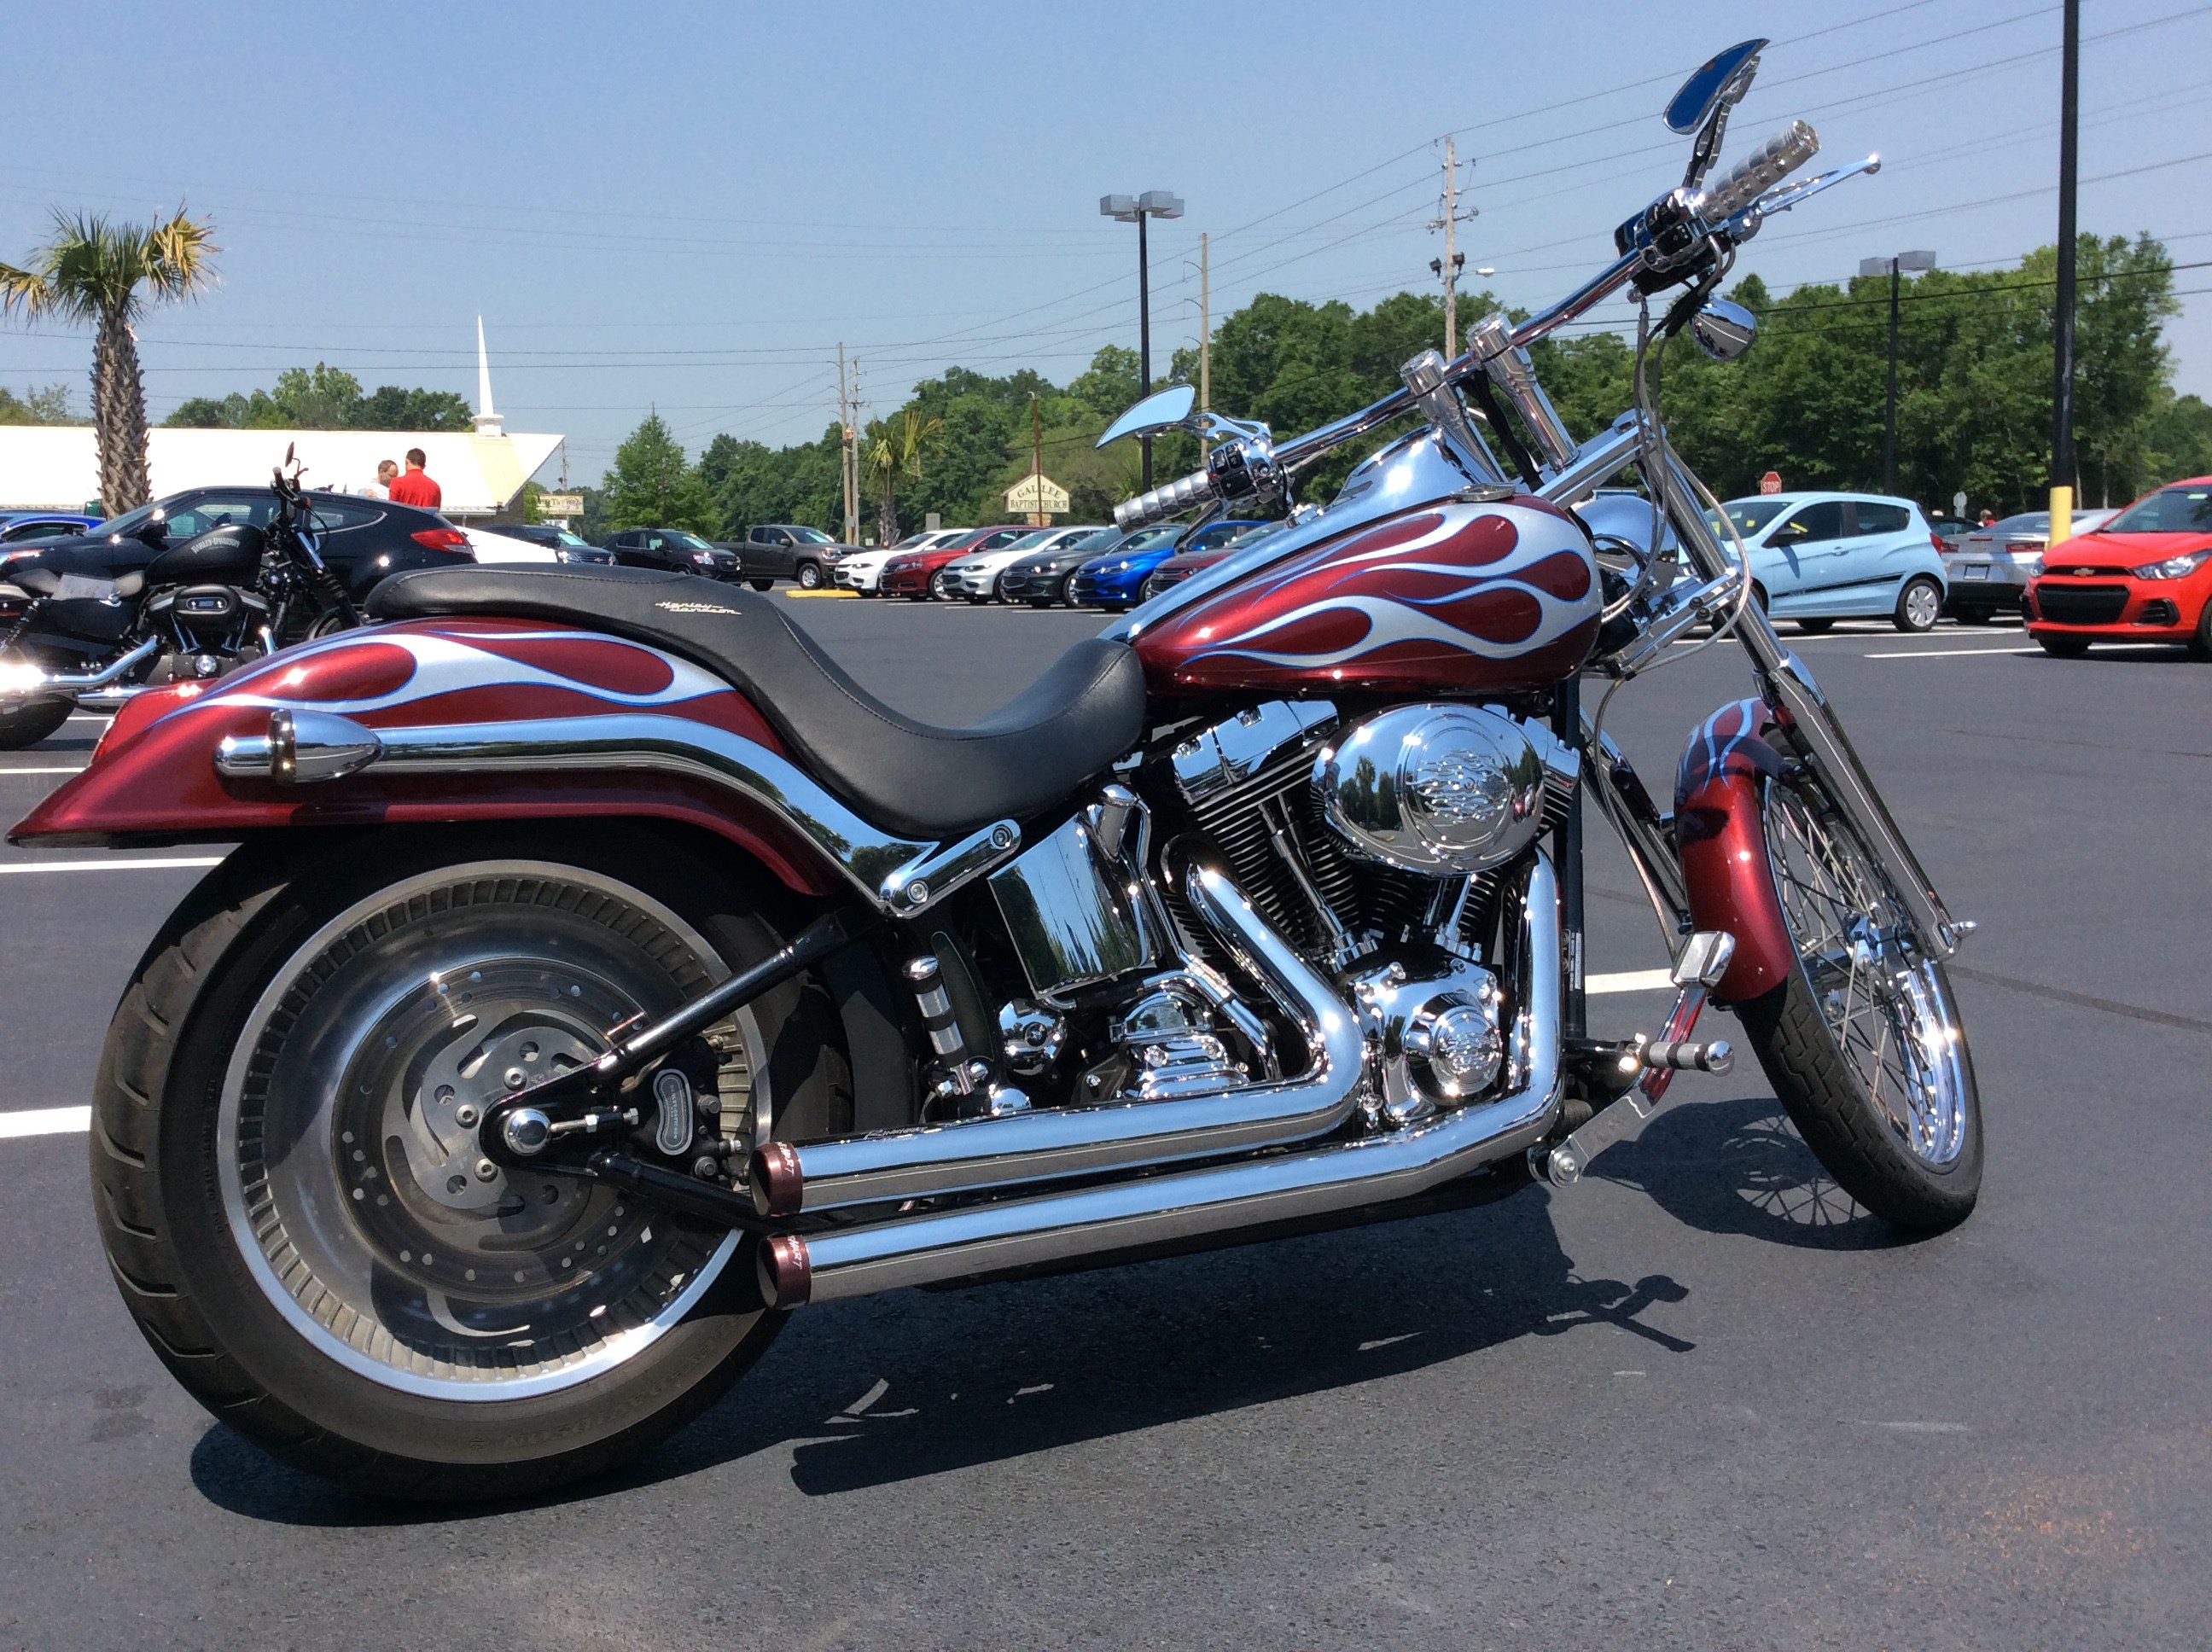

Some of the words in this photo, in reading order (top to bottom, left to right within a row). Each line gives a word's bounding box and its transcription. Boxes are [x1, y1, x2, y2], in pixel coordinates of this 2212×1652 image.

[1017, 485, 1062, 499] GALLEE
[1763, 481, 1779, 493] STOP
[1010, 500, 1038, 509] BAPTIST
[191, 537, 241, 555] HARLEY-DAVIDSON
[787, 1235, 803, 1270] EHART
